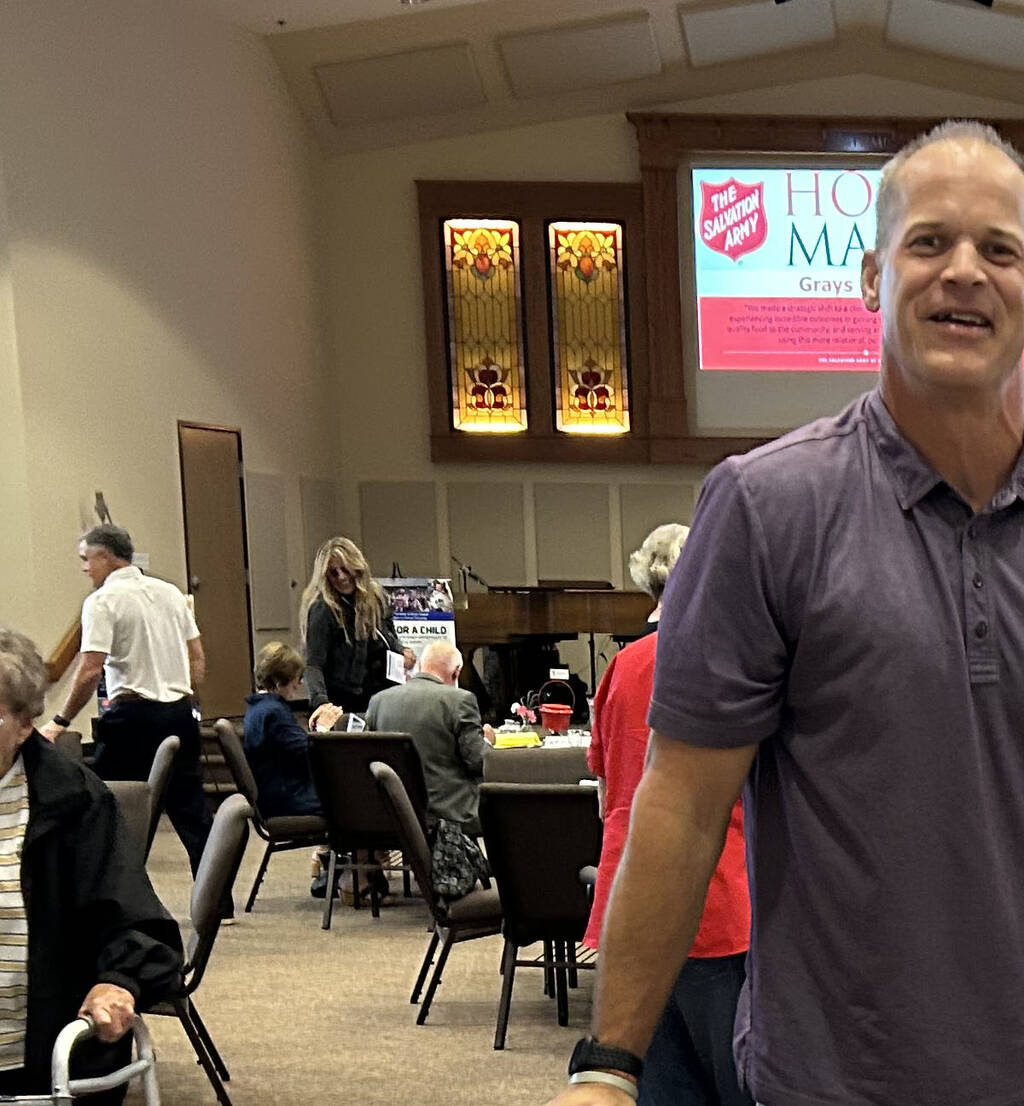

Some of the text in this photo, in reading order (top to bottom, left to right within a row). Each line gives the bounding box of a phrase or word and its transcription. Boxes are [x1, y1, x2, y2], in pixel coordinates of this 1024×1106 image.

[711, 185, 737, 212] THE
[786, 172, 872, 217] HO
[703, 188, 760, 241] SALVATION
[724, 213, 759, 251] ARMY
[799, 276, 853, 295] Grays
[396, 626, 447, 635] OR A CHILD
